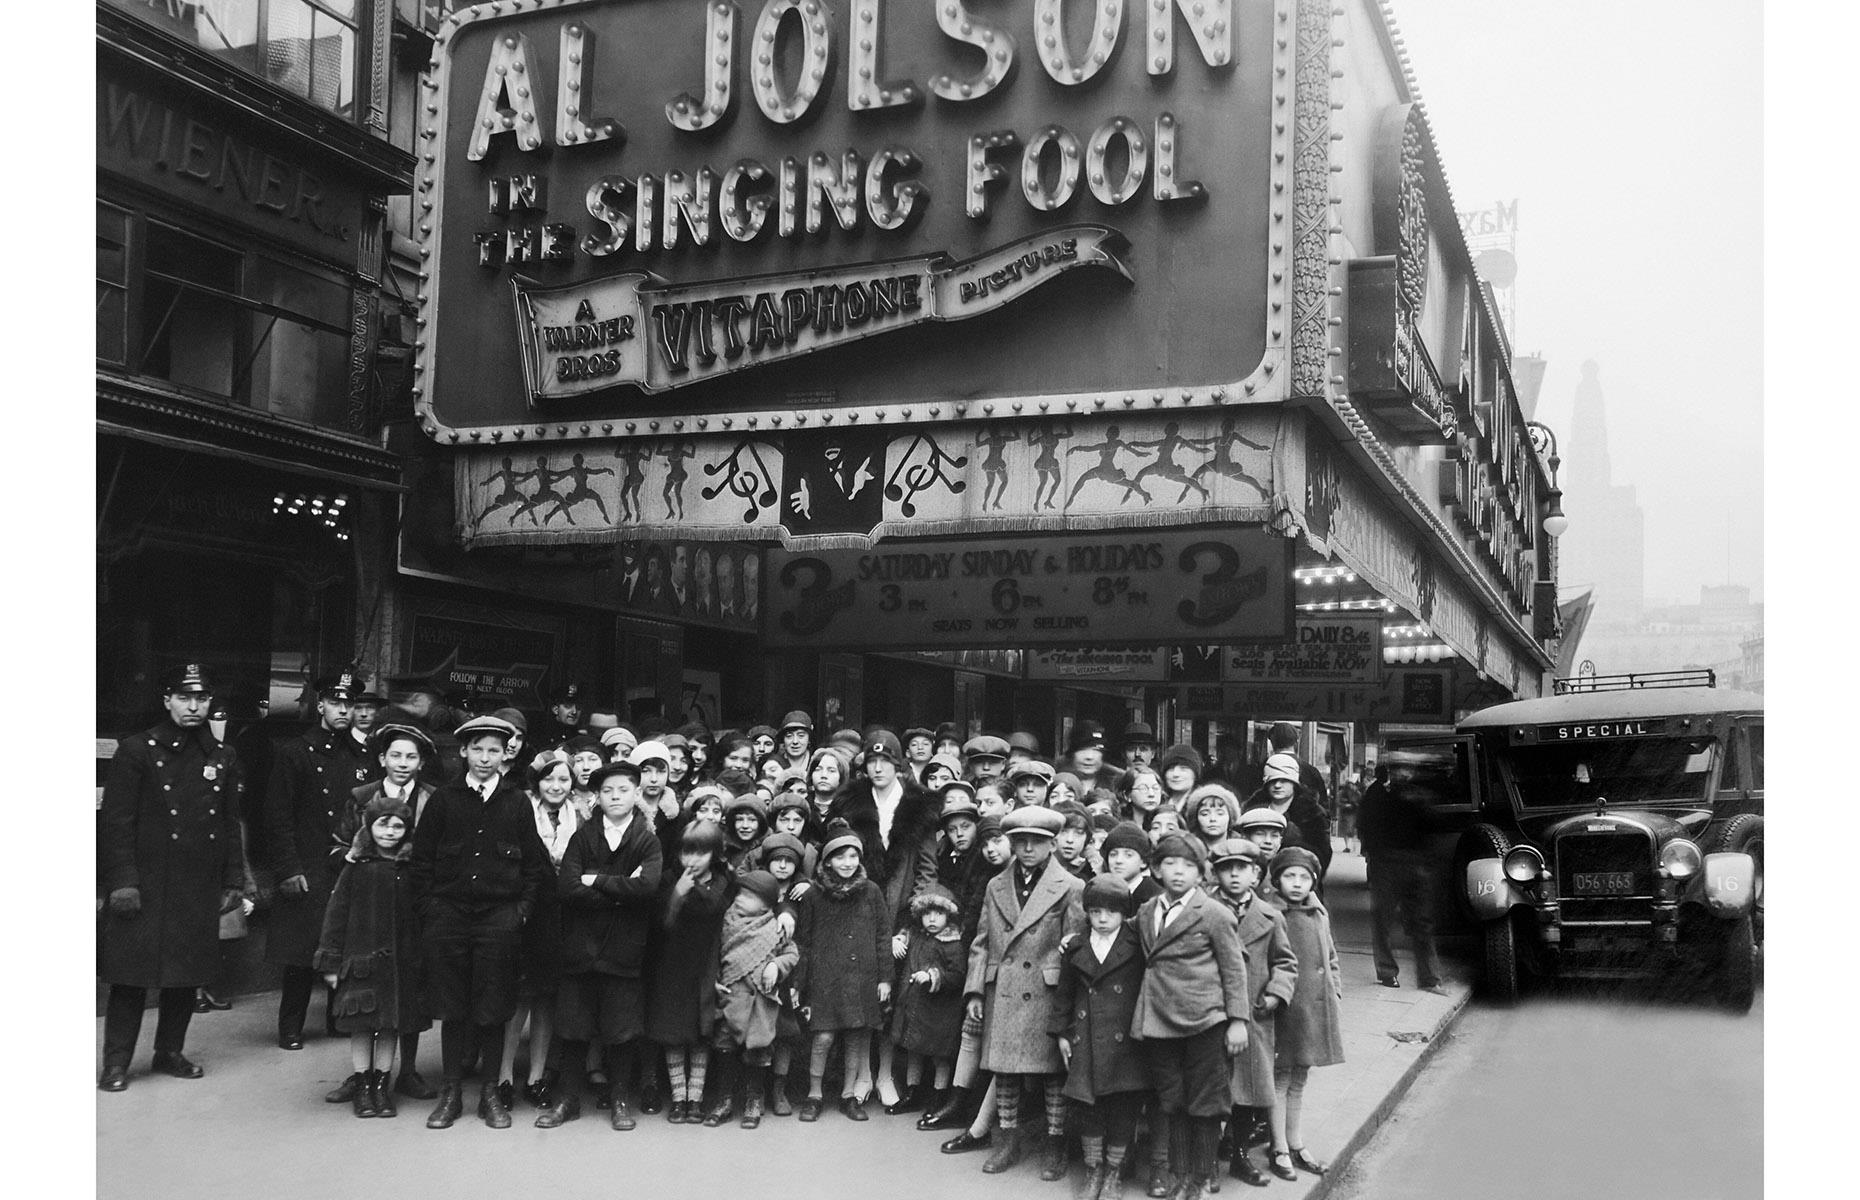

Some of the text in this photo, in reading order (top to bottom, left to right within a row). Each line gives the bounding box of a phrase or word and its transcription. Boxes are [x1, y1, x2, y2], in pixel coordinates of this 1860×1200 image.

[467, 0, 1238, 160] AL JOLSON
[107, 84, 324, 230] WIENER
[473, 111, 1210, 268] THE SINGING FOOL
[489, 173, 548, 214] IN
[960, 237, 1078, 304] PICTURE
[575, 298, 594, 320] A
[651, 275, 922, 373] VITAPHONE
[543, 314, 635, 350] WARNER
[556, 349, 622, 383] BROS
[858, 552, 955, 580] SATURDAY
[962, 549, 1037, 577] SUNDAY
[1067, 543, 1164, 573] HOLIDAYS
[879, 584, 902, 611] 3
[991, 578, 1021, 615] 6
[932, 616, 1089, 632] SEATS NOW SELLING
[1301, 626, 1340, 643] DAILY
[450, 672, 529, 688] FOLLOW THE ARROW
[1232, 657, 1371, 670] Seats Available NOW
[477, 685, 492, 693] NEXT
[496, 687, 514, 695] BLOCK
[1558, 723, 1646, 738] SPECIAL
[1478, 880, 1495, 896] 16
[1716, 876, 1739, 891] 16
